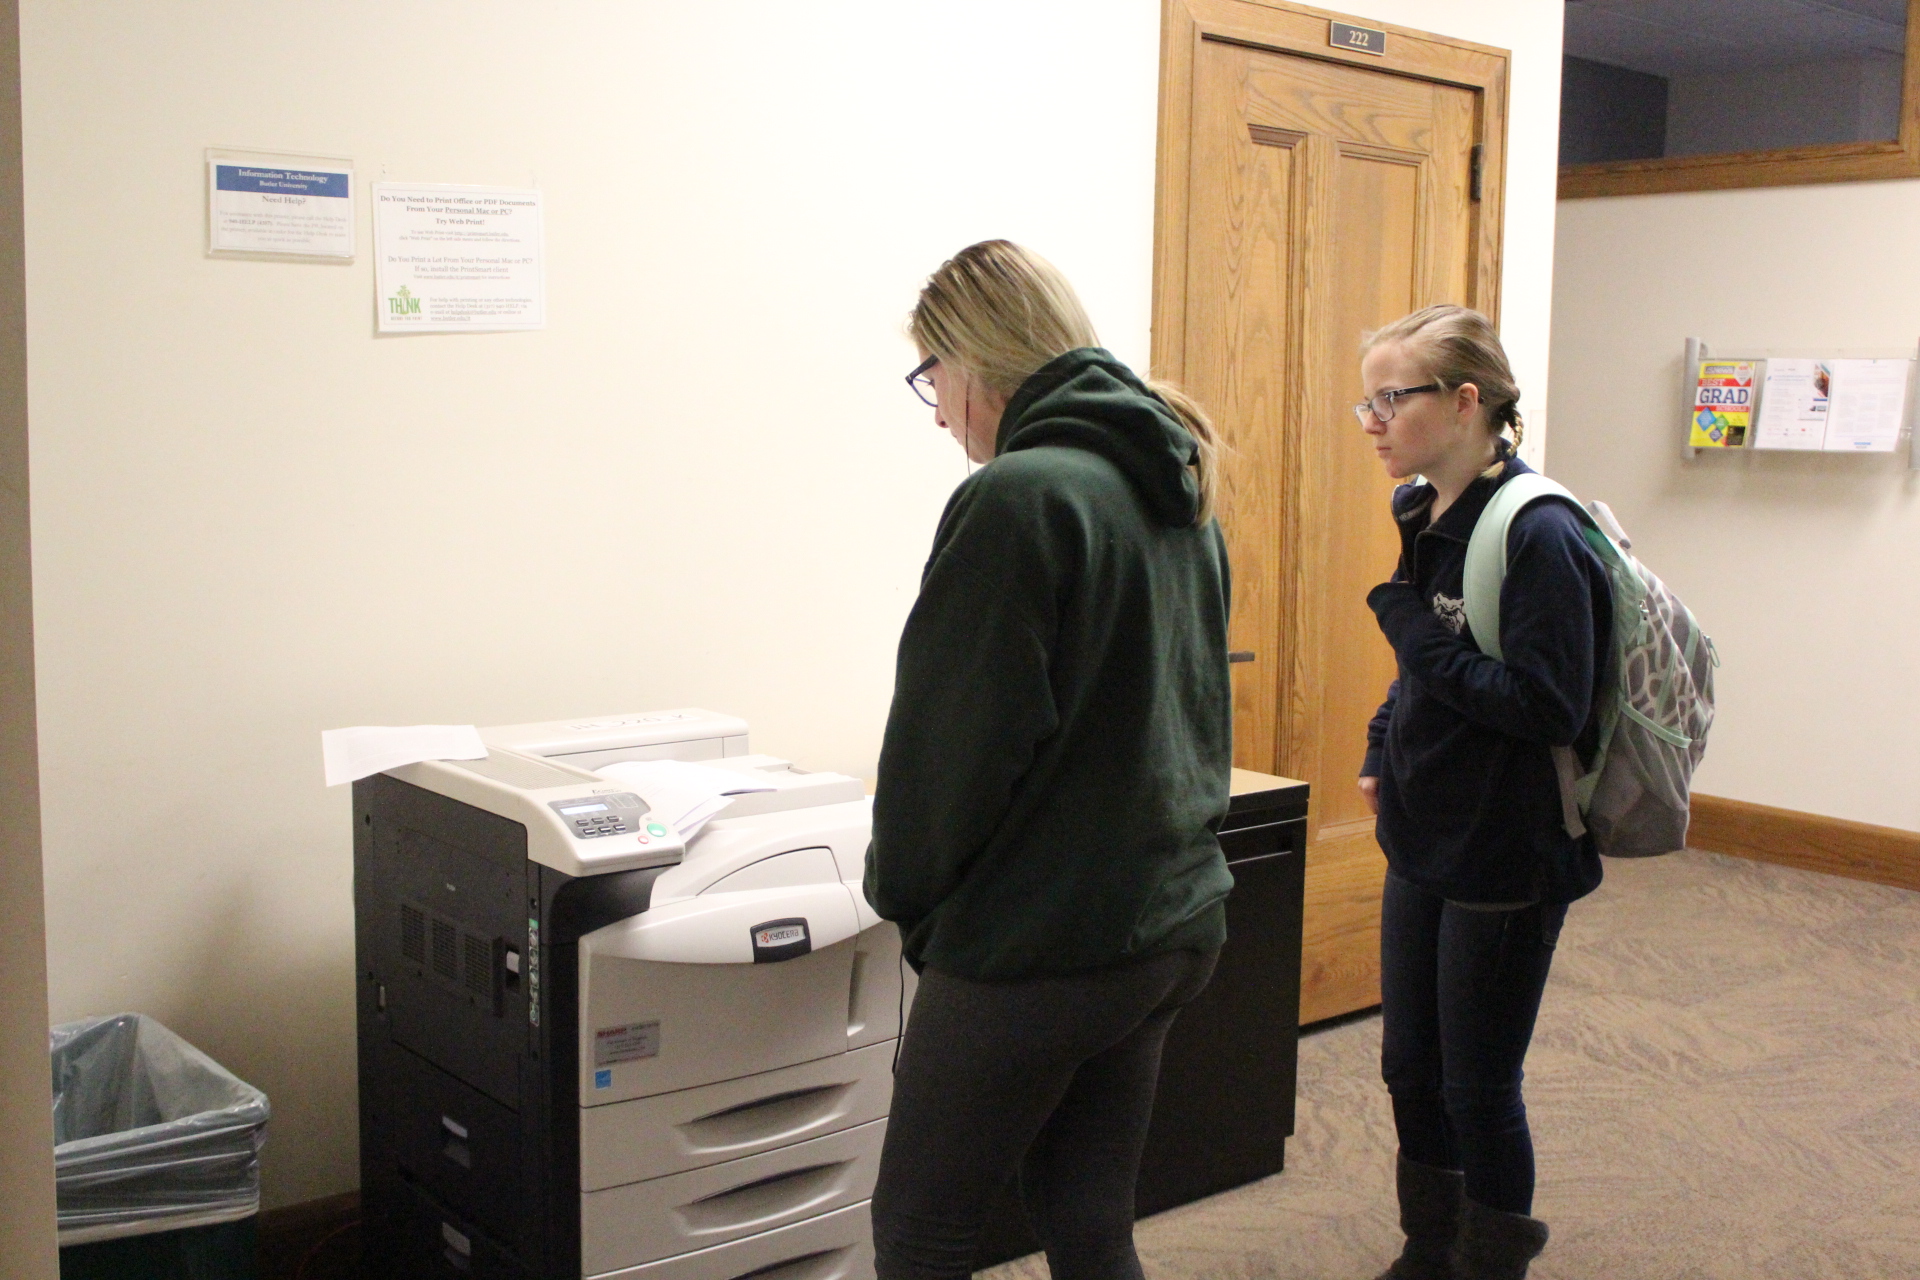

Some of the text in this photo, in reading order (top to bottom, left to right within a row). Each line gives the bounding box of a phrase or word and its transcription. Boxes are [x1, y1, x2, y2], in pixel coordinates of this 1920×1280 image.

[1349, 30, 1369, 46] 222
[238, 168, 328, 184] Information Technology
[279, 182, 308, 190] University
[284, 197, 306, 206] Help?
[388, 297, 421, 314] THINK
[1700, 388, 1748, 404] GRAD
